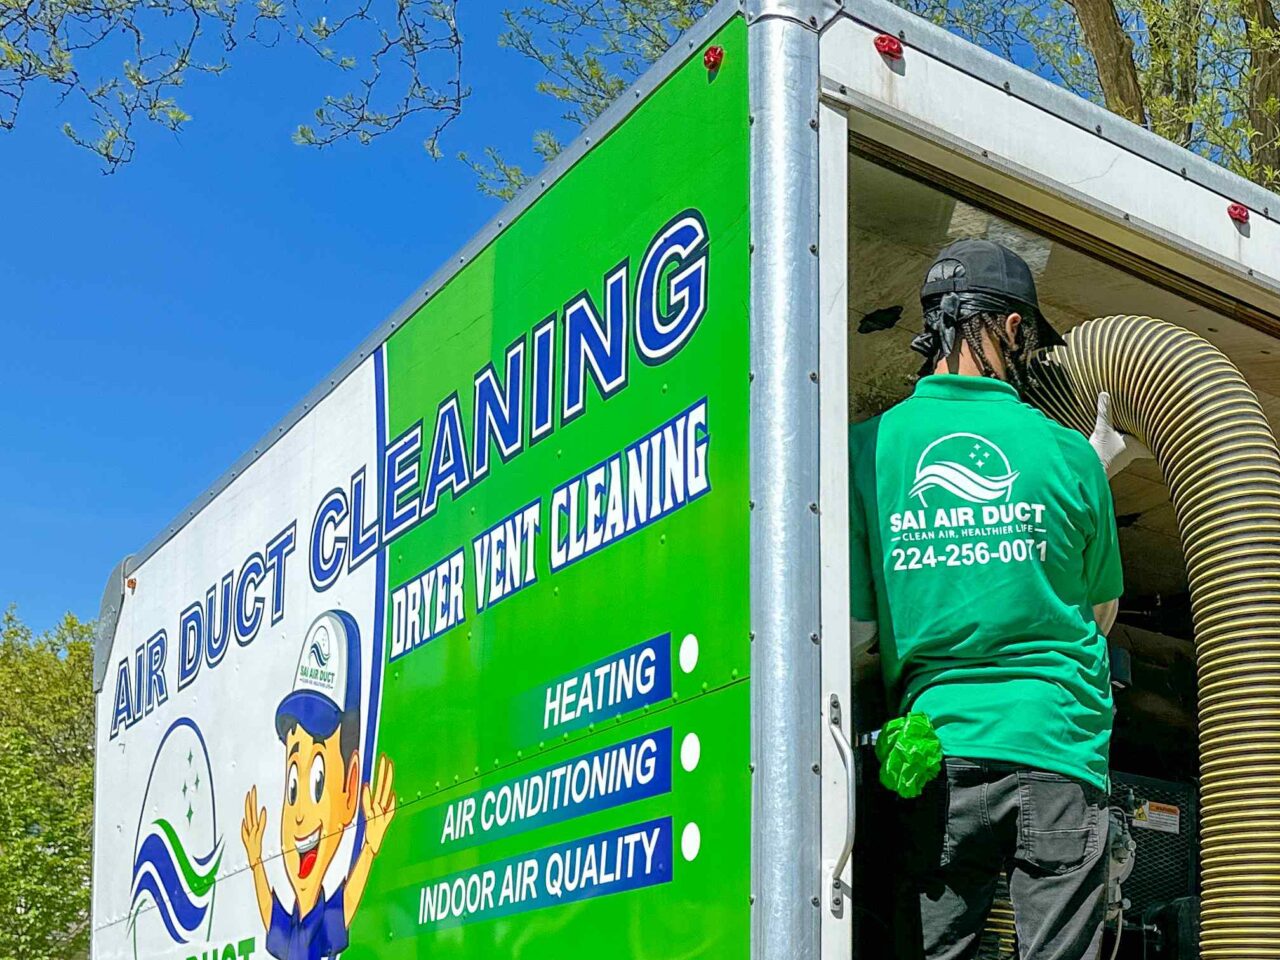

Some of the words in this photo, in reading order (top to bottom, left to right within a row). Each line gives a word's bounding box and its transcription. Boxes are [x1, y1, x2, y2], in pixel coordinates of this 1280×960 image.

[109, 628, 168, 741] AIR
[178, 519, 297, 693] DUCT
[309, 208, 710, 592] CLEANING
[890, 510, 926, 533] SAI
[934, 507, 975, 528] AIR
[982, 502, 1046, 525] DUCT
[388, 546, 466, 663] DRYER
[472, 496, 542, 615] VENT
[550, 395, 712, 574] CLEANING
[892, 539, 1047, 571] 224-256-0071
[902, 530, 935, 542] CLEAN
[938, 530, 959, 539] AIR,
[961, 525, 1013, 537] HEALTHIER
[1016, 524, 1034, 534] LIFE
[543, 647, 656, 729] HEATING
[441, 798, 475, 844] AIR
[481, 738, 657, 832] CONDITIONING
[418, 869, 496, 924] INDOOR
[499, 858, 538, 906] AIR
[545, 828, 660, 898] QUALITY
